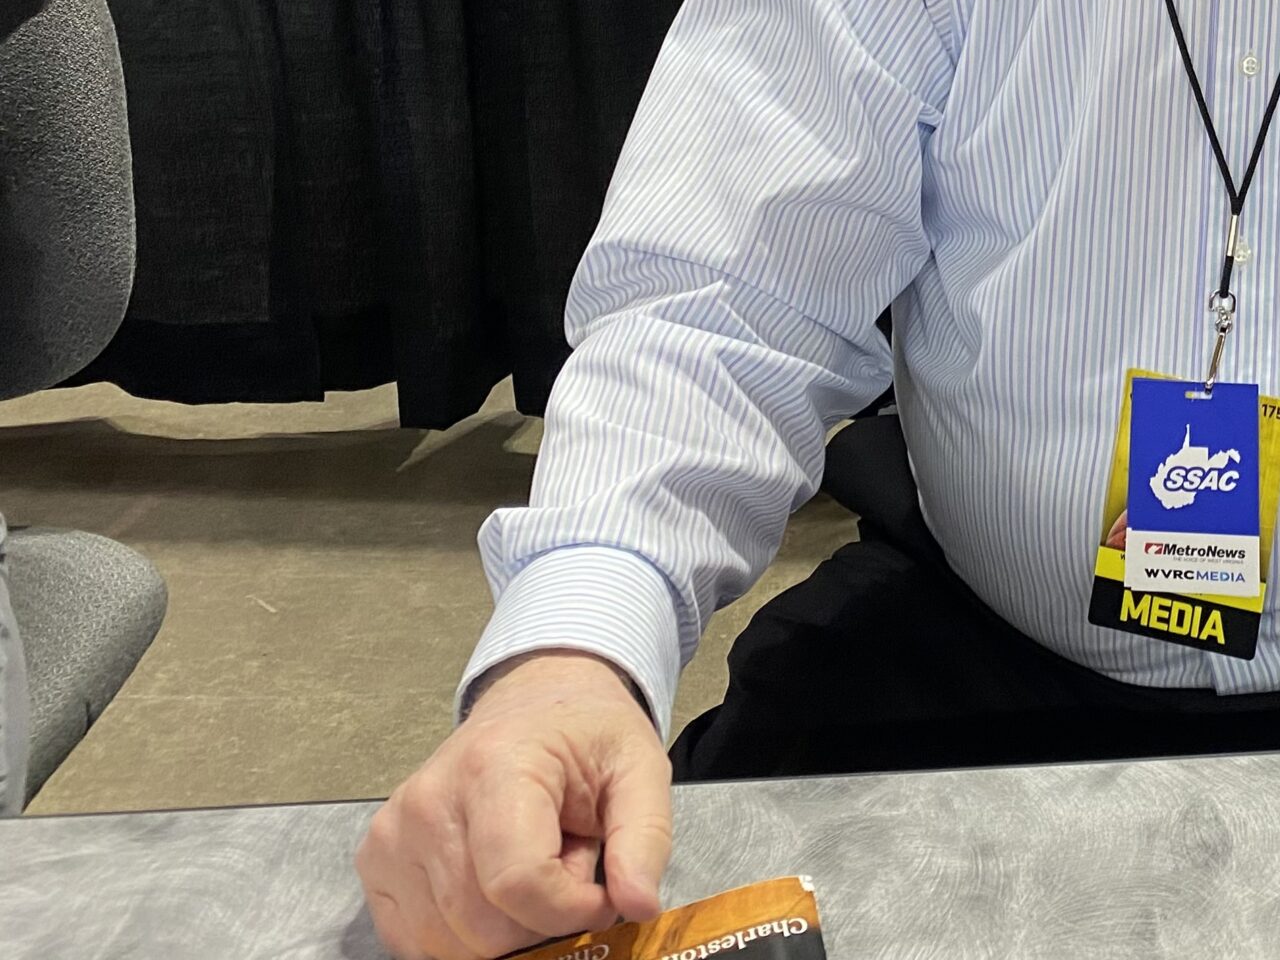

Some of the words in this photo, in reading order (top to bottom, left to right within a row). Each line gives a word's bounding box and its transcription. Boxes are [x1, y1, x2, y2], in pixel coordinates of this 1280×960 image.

[1164, 467, 1240, 492] SSAC
[1163, 543, 1246, 559] MetroNews
[1120, 590, 1225, 645] MEDIA
